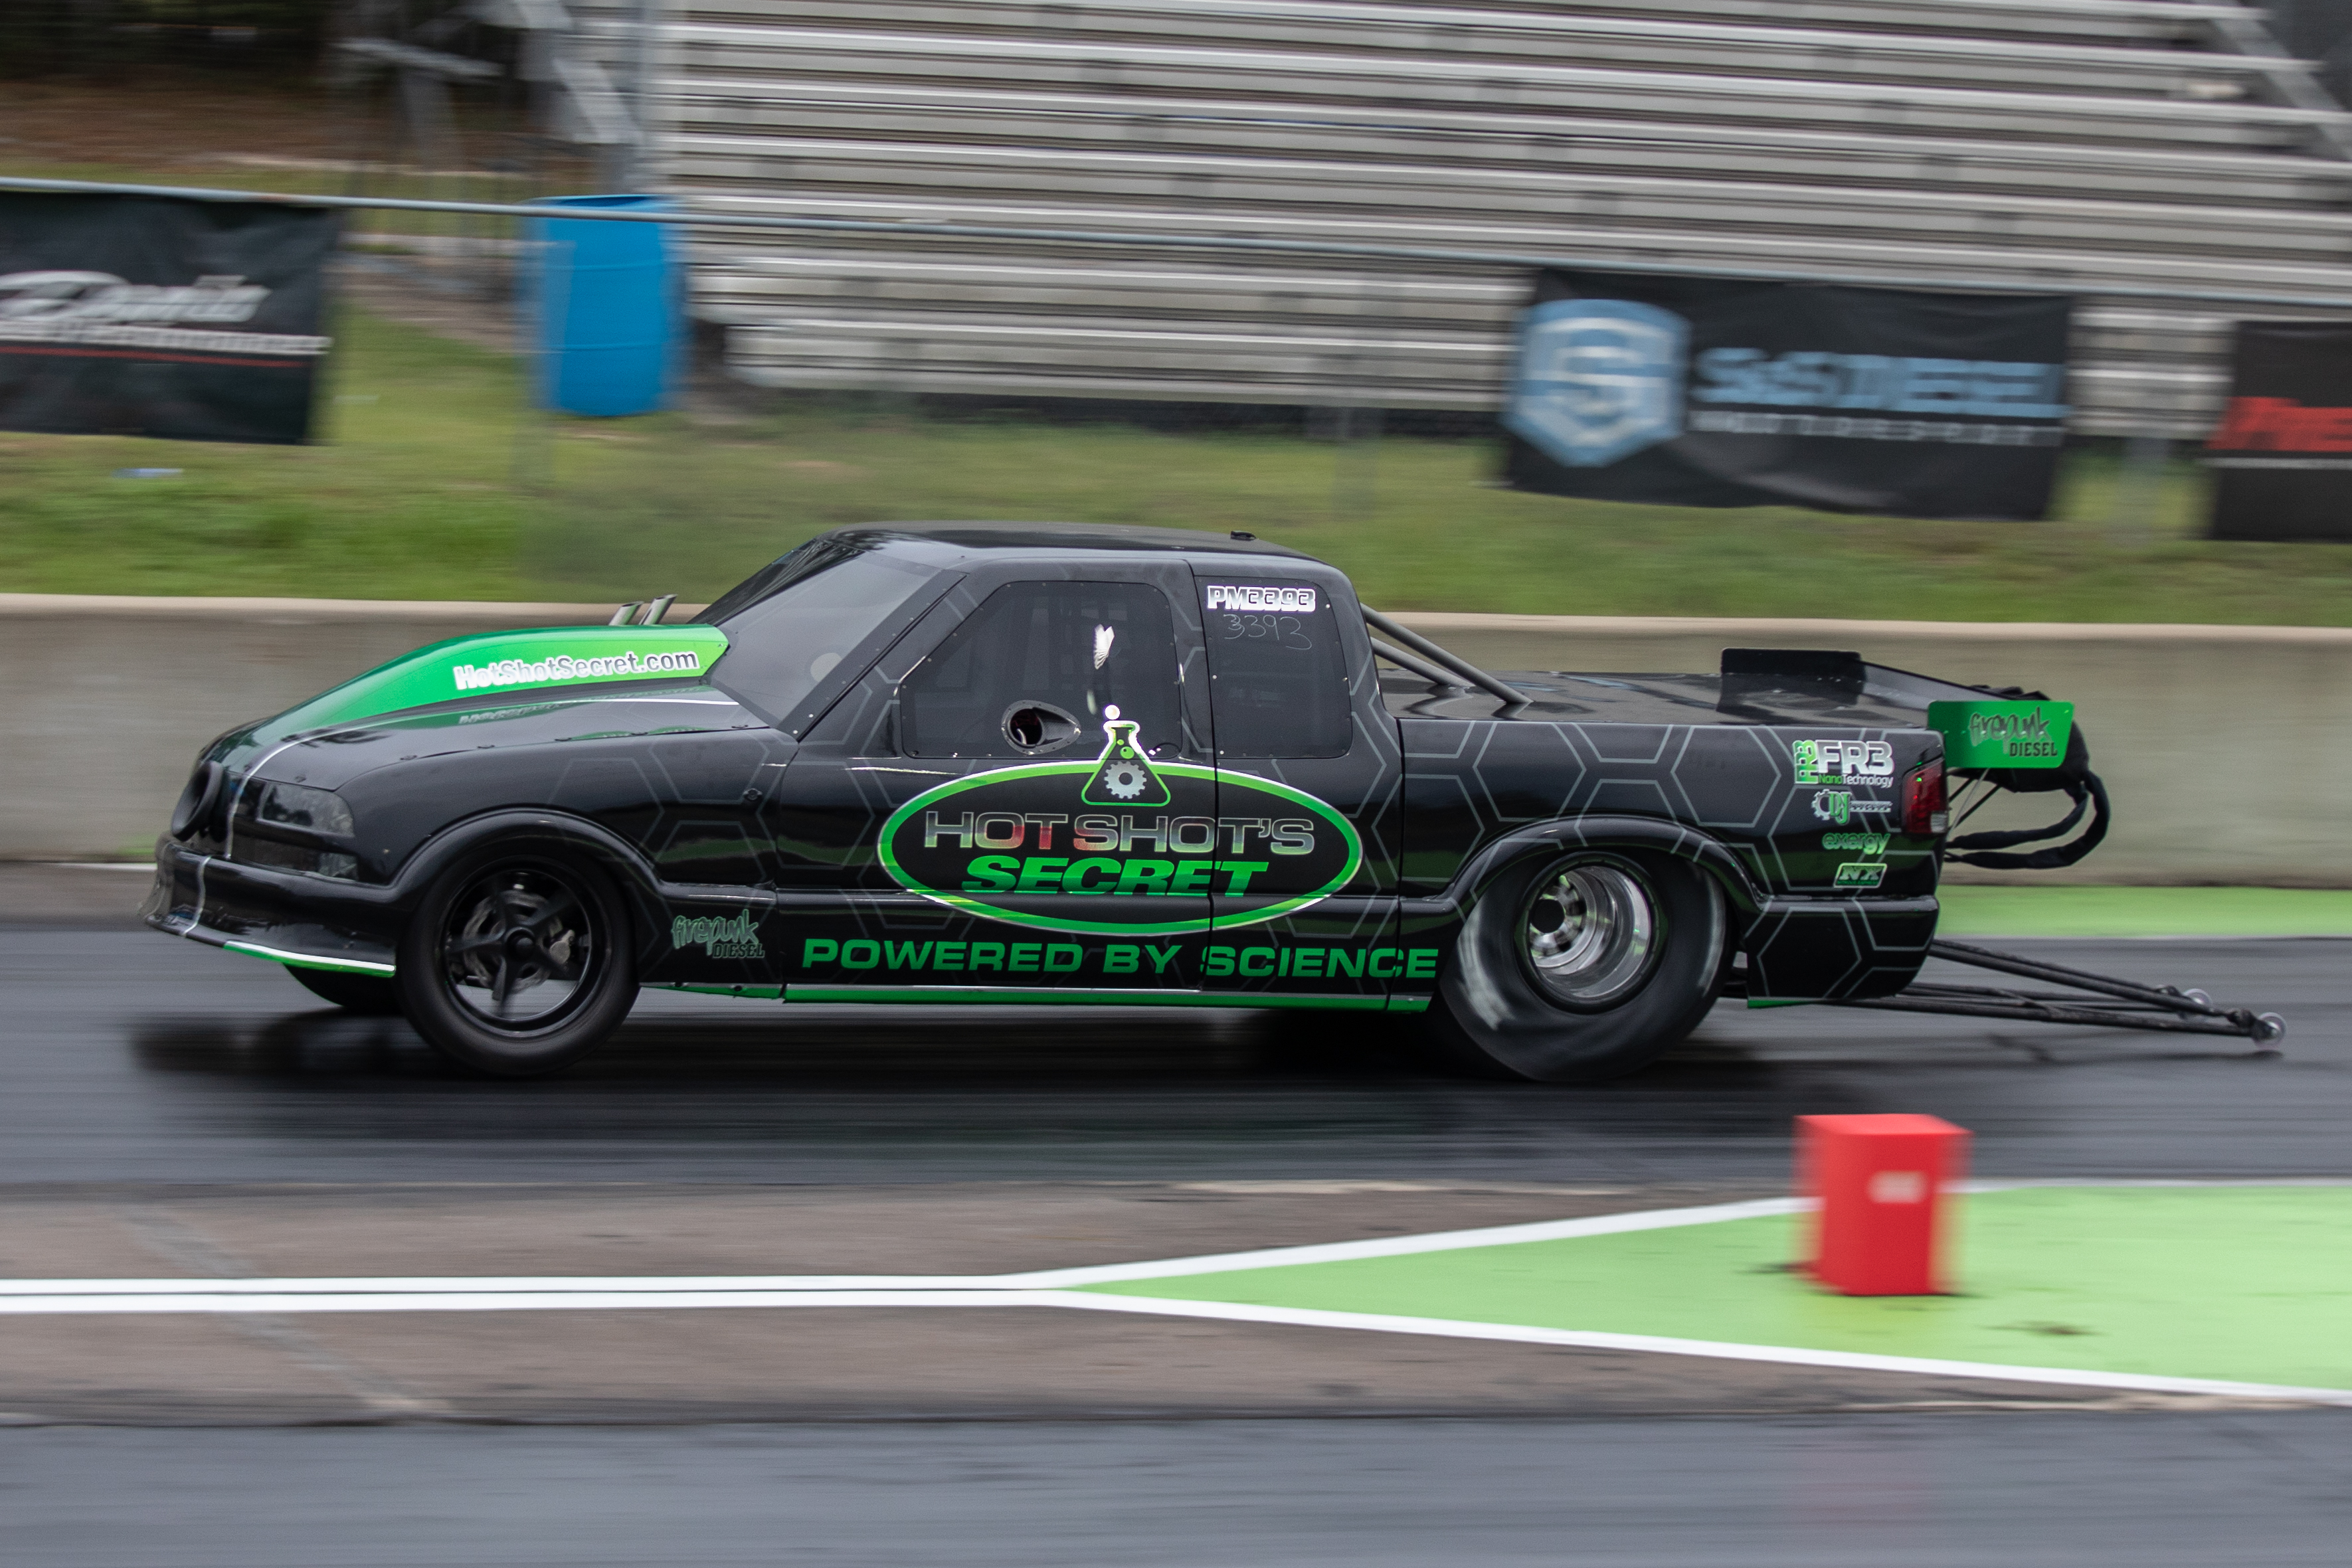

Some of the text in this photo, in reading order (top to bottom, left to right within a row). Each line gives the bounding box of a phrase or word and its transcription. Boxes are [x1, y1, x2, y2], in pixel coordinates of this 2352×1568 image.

[1207, 585, 1316, 612] PM3393
[453, 650, 700, 691] HotShotSecret.com
[1815, 739, 1894, 776] FR3
[2009, 741, 2058, 757] DIESEL
[925, 811, 1316, 855] HOT SHOT'S
[1822, 832, 1891, 855] exergy
[960, 855, 1269, 897] SECRET
[1839, 866, 1882, 881] NX
[713, 943, 765, 958] DIESEL
[802, 938, 1439, 979] POWERED BY SCIENCE
